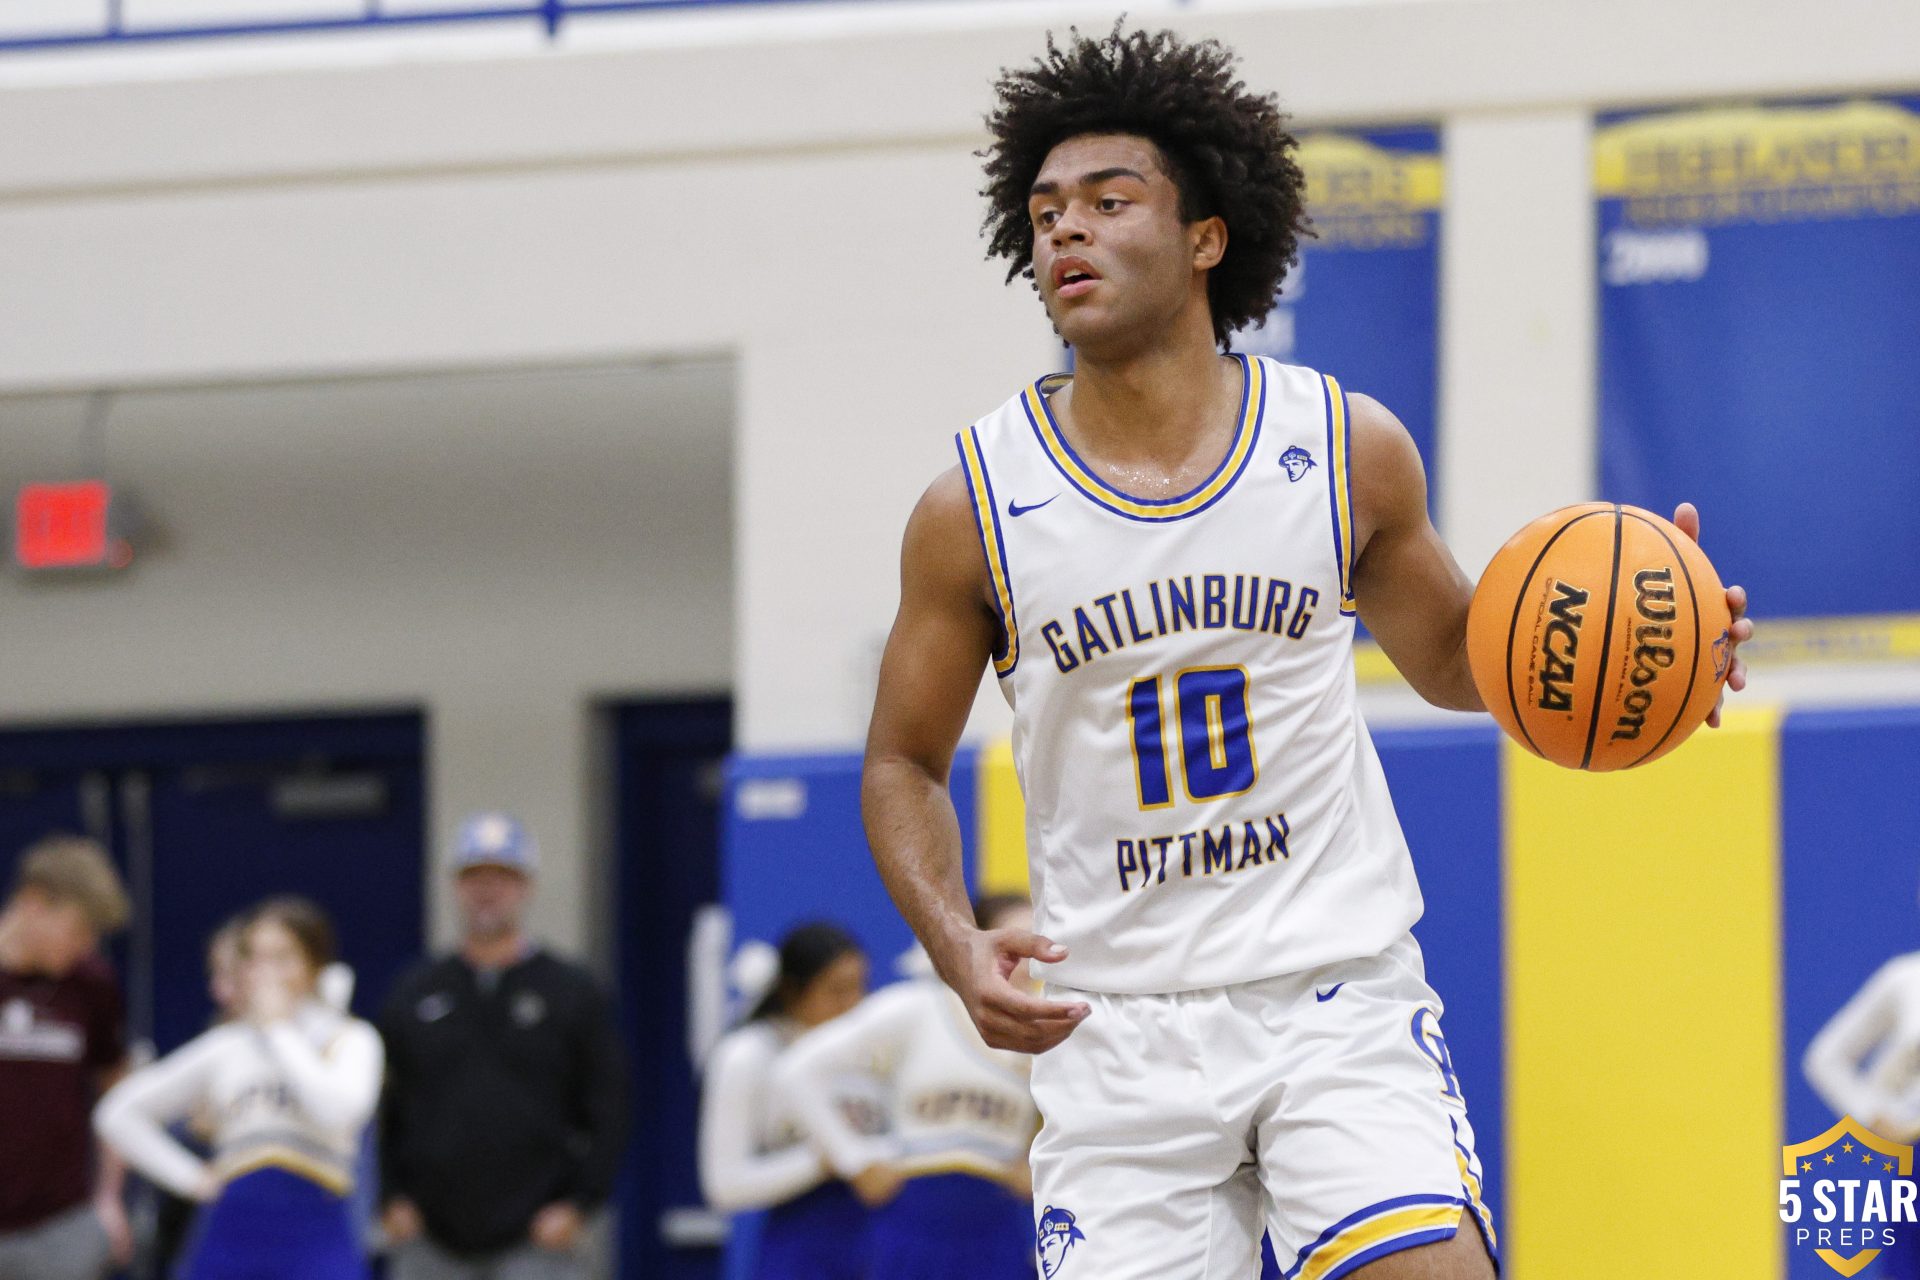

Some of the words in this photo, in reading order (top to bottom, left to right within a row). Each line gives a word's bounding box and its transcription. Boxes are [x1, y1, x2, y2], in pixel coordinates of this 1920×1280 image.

[1039, 573, 1321, 676] GATLINBURG
[1538, 579, 1590, 711] NCAA
[1610, 566, 1677, 740] Wilson
[1125, 663, 1260, 812] 10
[1115, 813, 1290, 893] PITTMAN
